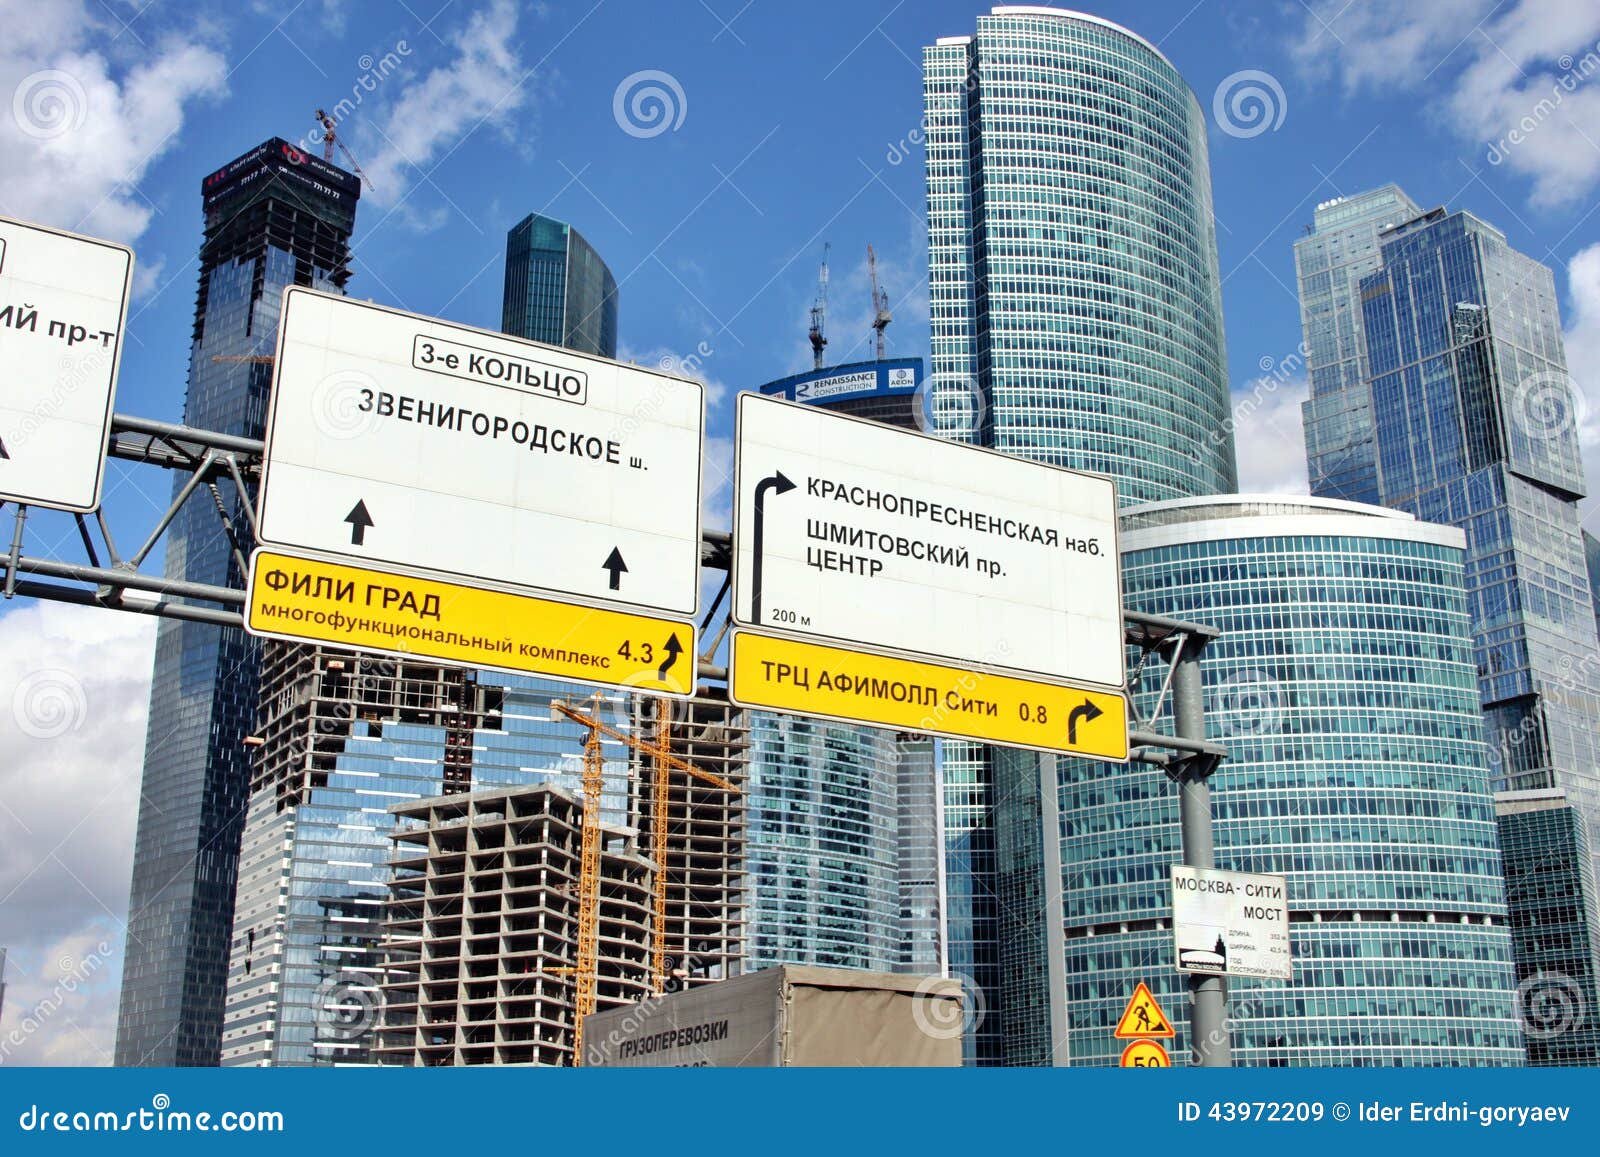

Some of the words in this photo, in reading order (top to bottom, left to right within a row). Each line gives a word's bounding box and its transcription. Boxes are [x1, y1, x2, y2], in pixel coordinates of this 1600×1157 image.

[48, 320, 115, 347] пр-т
[468, 353, 582, 396] КОЛЬЦО
[813, 372, 875, 389] RENAISSANCE
[813, 382, 873, 397] CONSTRUCTION
[357, 388, 621, 464] ЗВЕНИГОРОДСКОЕ
[629, 455, 649, 471] ш.
[807, 476, 1059, 547] КРАСНОПРЕСНЕНСКАЯ
[1065, 536, 1105, 557] наб.
[807, 518, 970, 569] ШМИТОВСКИЙ
[976, 557, 1007, 578] пр.
[807, 546, 884, 577] ЦЕНТР
[264, 569, 355, 603] ФИЛИ
[366, 584, 441, 622] ГРАД
[260, 603, 513, 654] многофункциональный
[519, 643, 611, 669] комплекс
[617, 639, 654, 664] 4.3
[772, 608, 796, 624] 200
[800, 615, 811, 626] м
[761, 660, 809, 690] ТРЦ
[816, 670, 938, 707] АФИМОЛЛ
[945, 691, 998, 717] Сити
[1018, 702, 1048, 725] 0.8
[1245, 884, 1282, 899] СИТИ
[1244, 906, 1283, 921] МОСТ
[619, 1020, 729, 1060] ГРУЗОПЕРЕВОЗКИ
